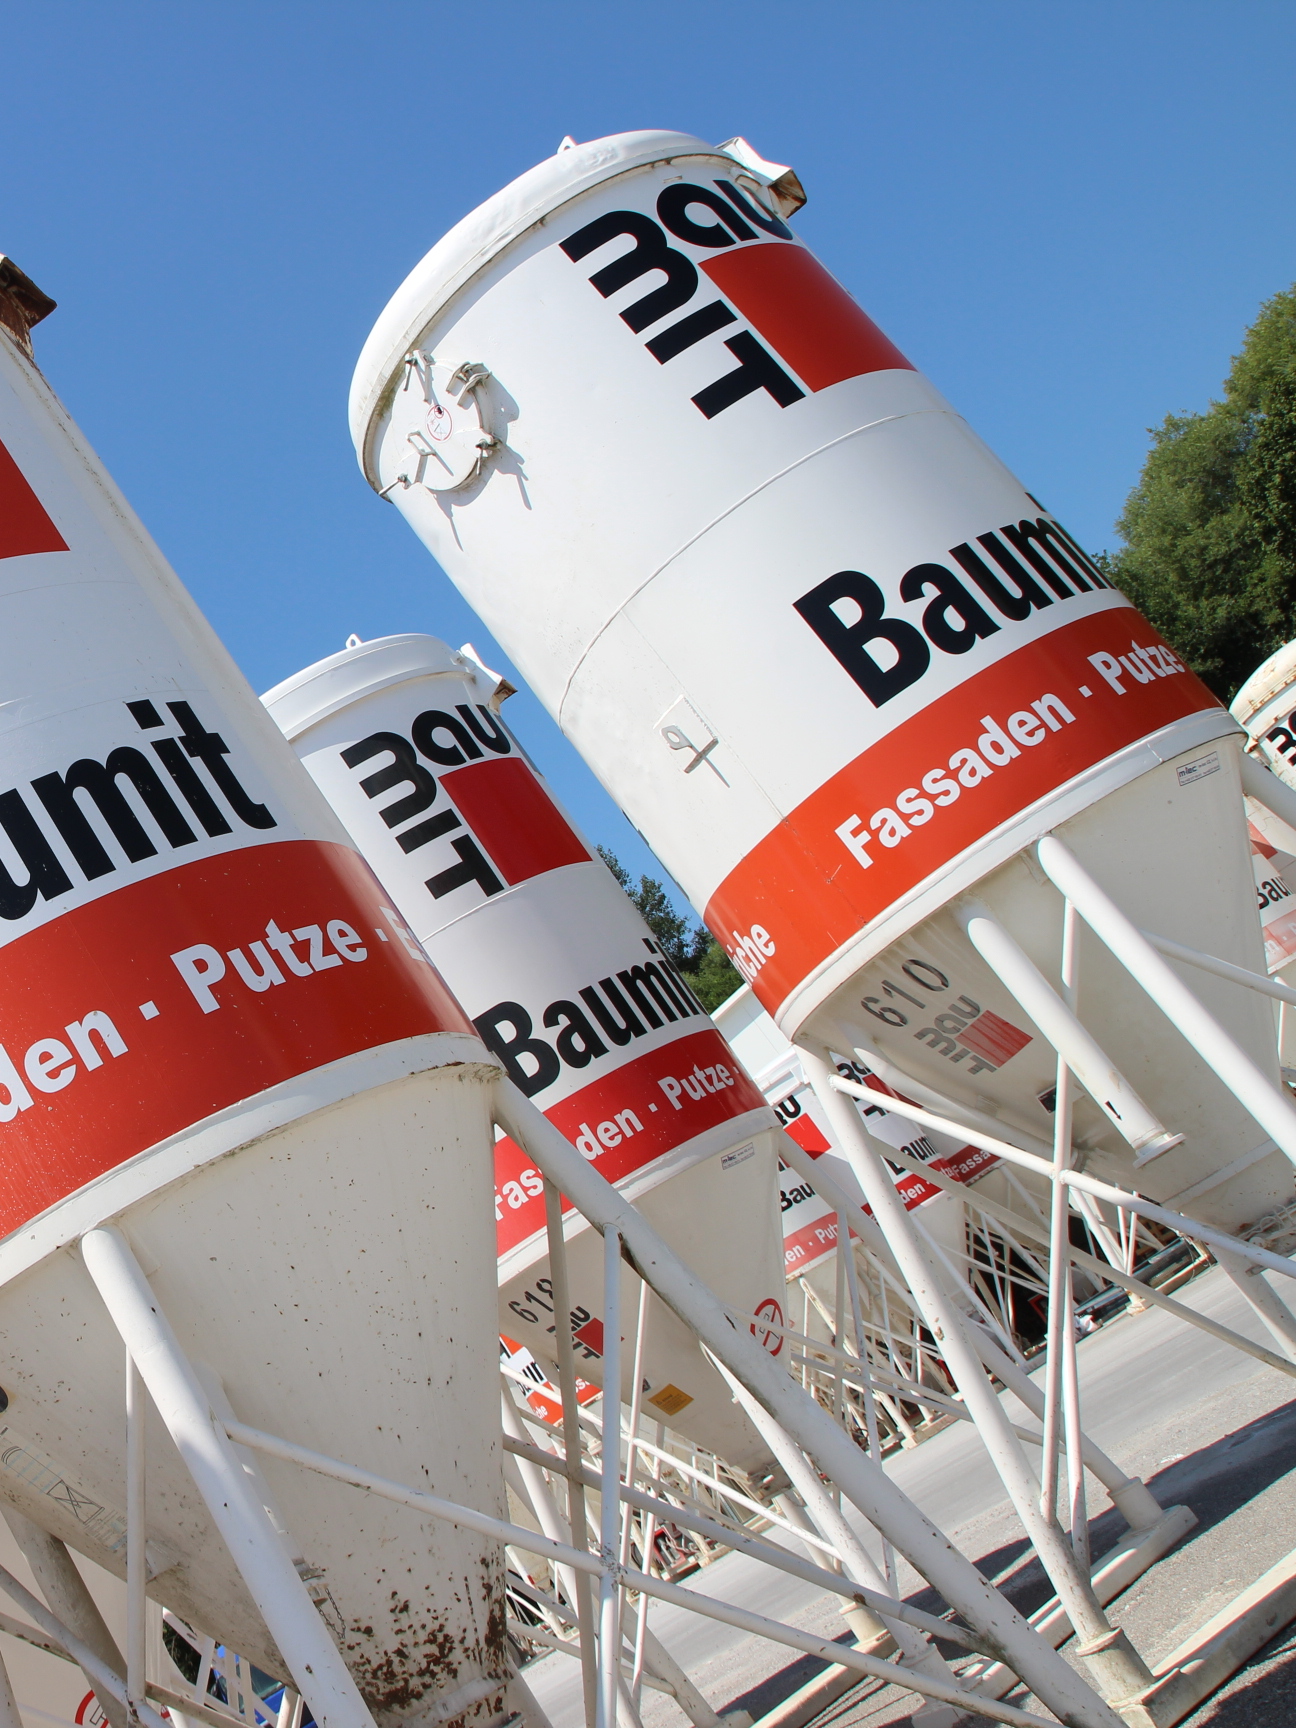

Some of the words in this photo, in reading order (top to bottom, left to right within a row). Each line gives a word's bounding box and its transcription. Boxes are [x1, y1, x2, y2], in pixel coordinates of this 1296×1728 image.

[834, 691, 1077, 869] Fassaden
[1086, 640, 1186, 696] Putze
[170, 918, 368, 1015] Putze
[860, 959, 950, 1027] 610
[657, 1064, 735, 1111] Putze
